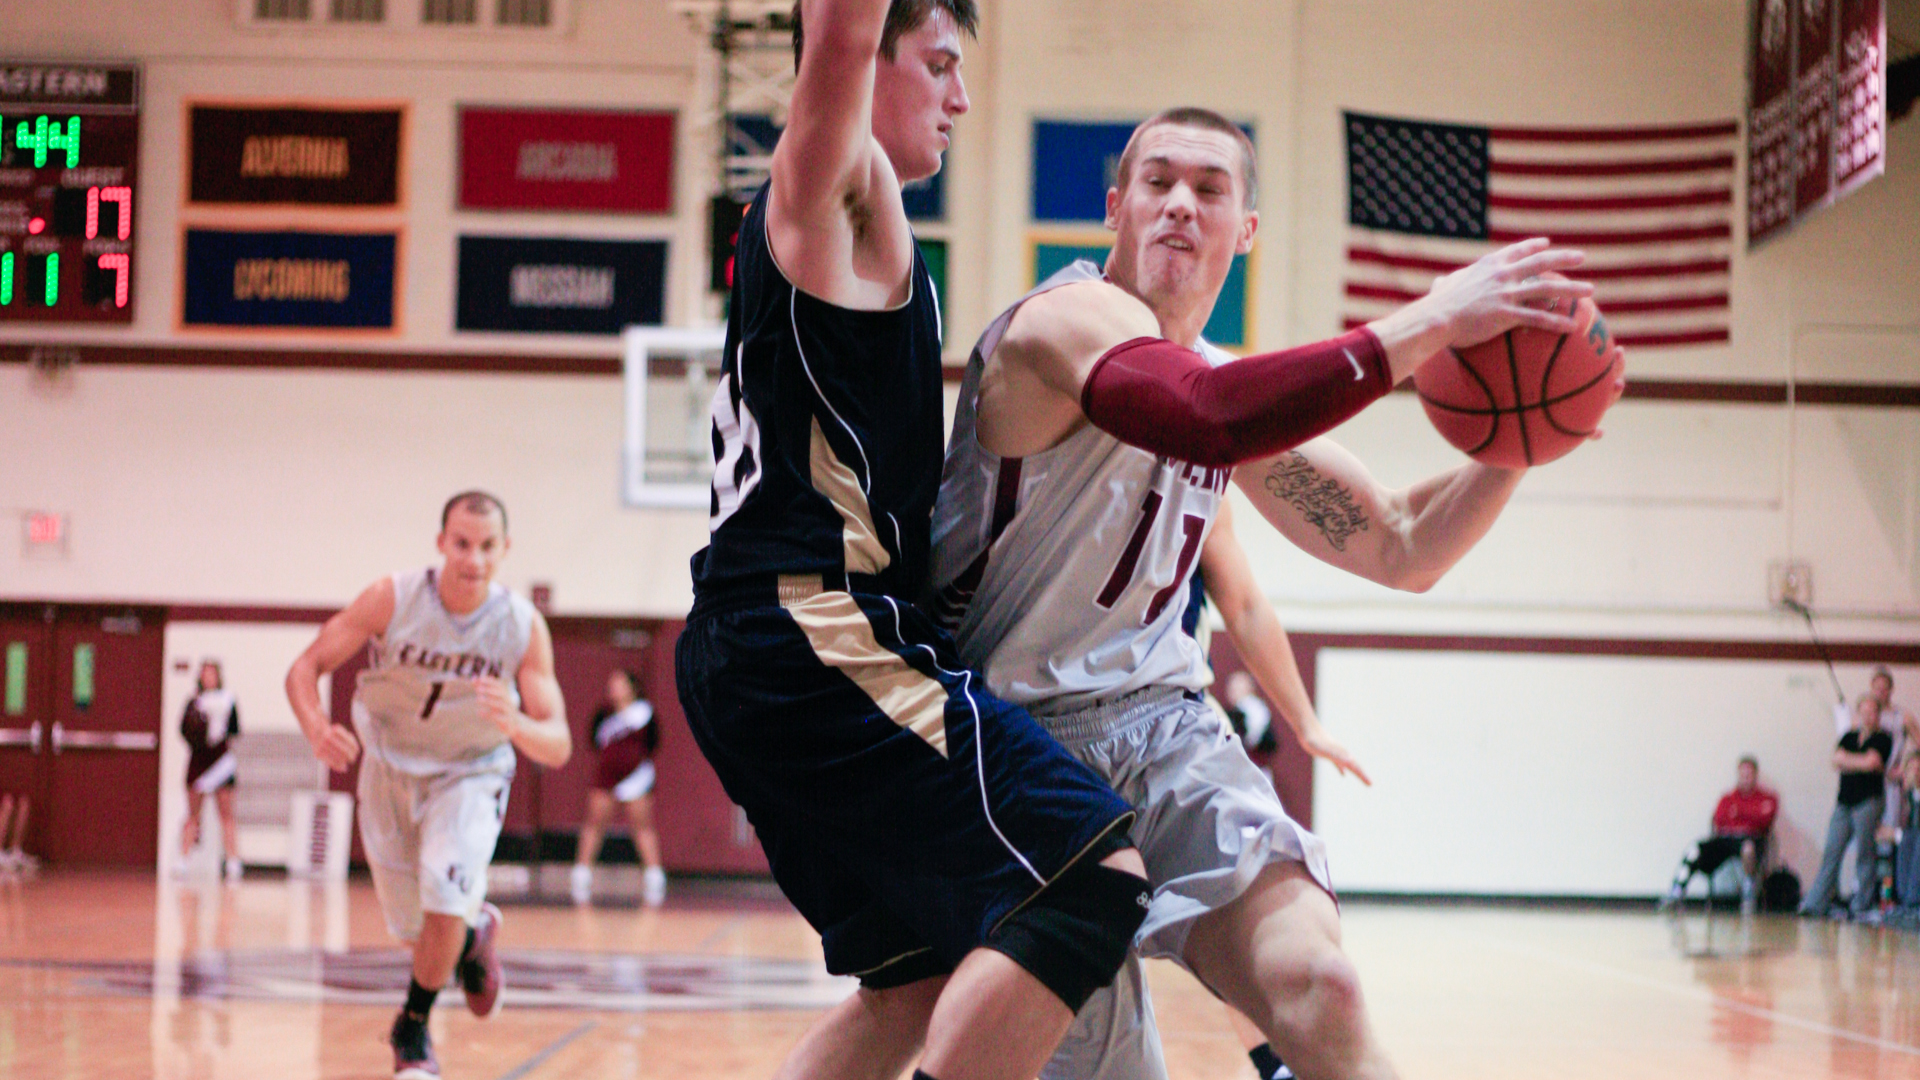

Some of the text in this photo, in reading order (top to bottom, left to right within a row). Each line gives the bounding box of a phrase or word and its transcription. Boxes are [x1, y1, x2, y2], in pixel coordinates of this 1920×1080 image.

[86, 186, 131, 240] 17
[98, 253, 129, 308] 7
[420, 681, 444, 720] 1
